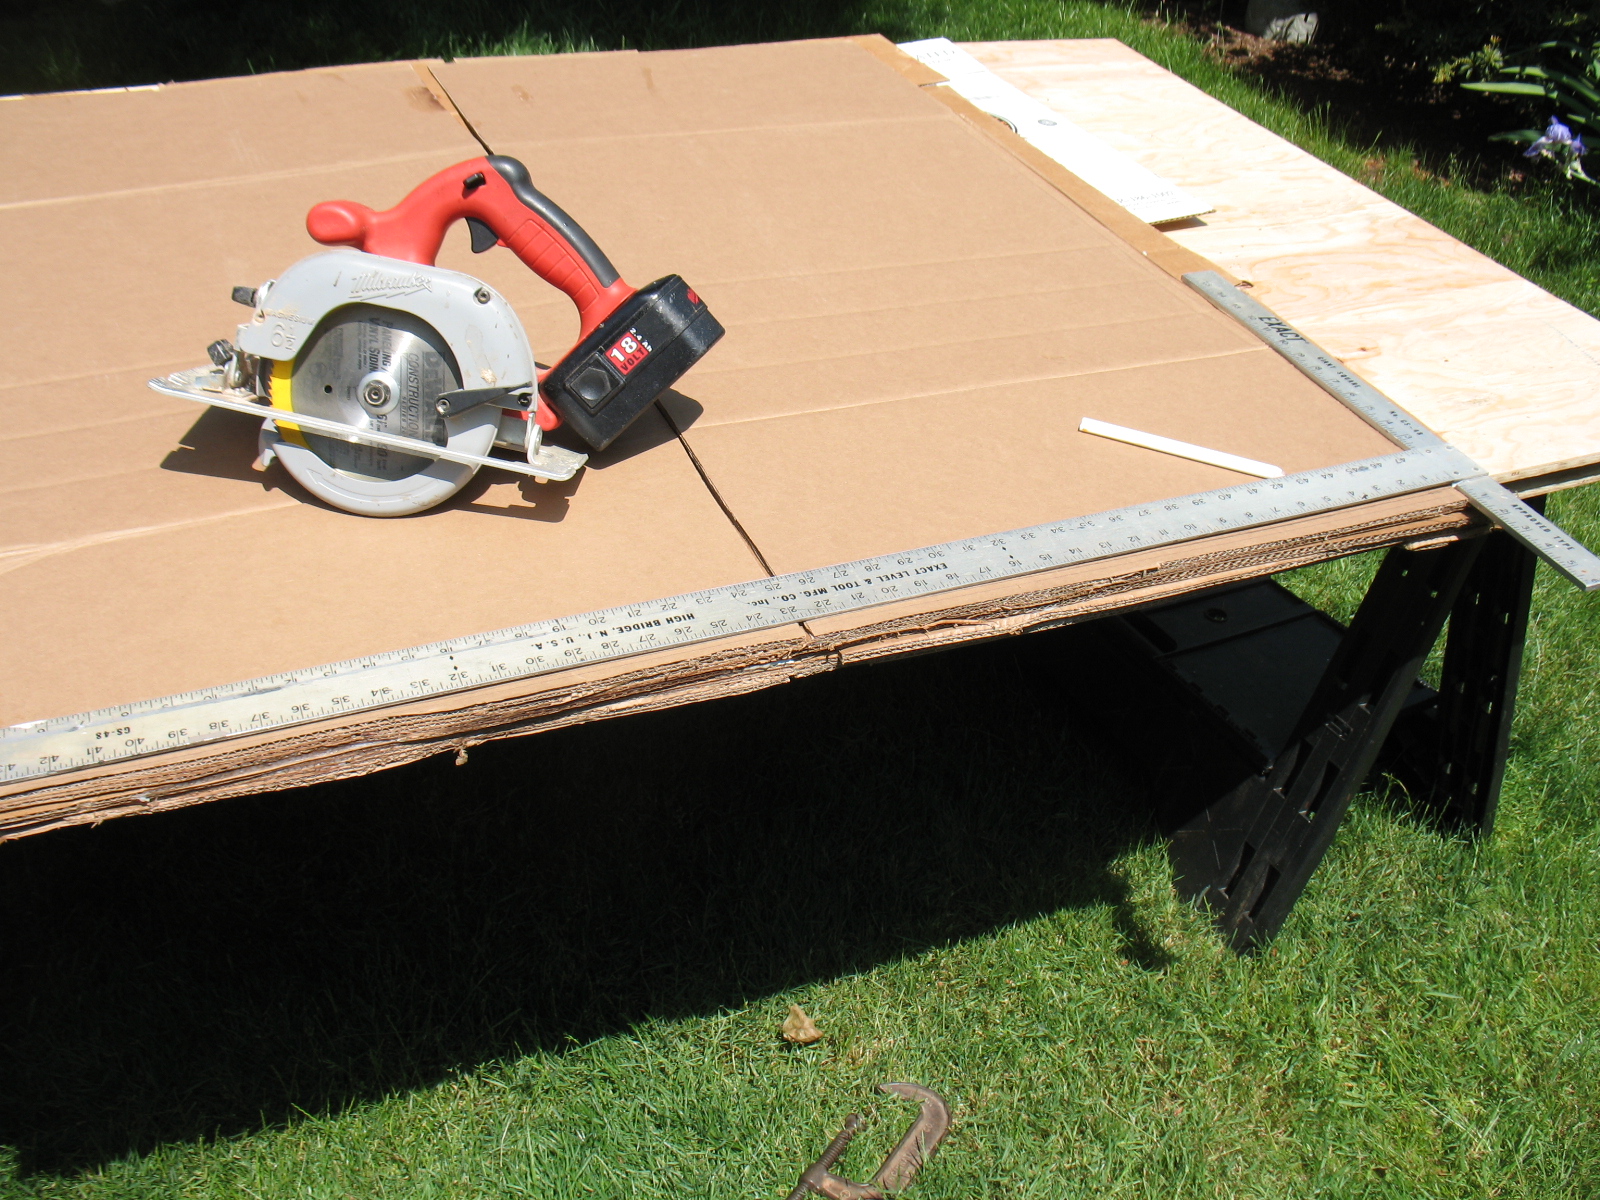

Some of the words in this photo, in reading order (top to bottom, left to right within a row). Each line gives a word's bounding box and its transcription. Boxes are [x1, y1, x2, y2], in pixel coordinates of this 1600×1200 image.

[629, 327, 643, 341] 2.4
[1258, 316, 1307, 342] EXACT
[610, 336, 638, 362] 18
[369, 347, 380, 372] SIDIN
[620, 347, 645, 371] VOLT
[407, 352, 420, 439] CONSTRUCTION
[1511, 504, 1551, 532] APPROVED
[1553, 535, 1575, 550] TYPE
[914, 562, 949, 575] EXACT
[864, 577, 873, 585] &
[876, 570, 911, 582] LEVEL
[946, 572, 960, 580] 18
[830, 580, 862, 592] TOOL
[914, 579, 928, 587] 19
[799, 587, 829, 598] MFG.
[881, 585, 898, 594] 20
[851, 592, 865, 601] 21
[747, 598, 771, 607] Inc.
[814, 599, 832, 608] 22
[780, 606, 797, 615] 23
[665, 613, 696, 625] HIGH
[745, 612, 763, 621] 24
[612, 619, 661, 634] BRIDGE,
[710, 620, 727, 629] 25
[674, 626, 693, 635] 26
[639, 633, 656, 643] 27
[601, 640, 620, 650] 28
[564, 647, 583, 657] 29
[526, 655, 545, 665] 30
[449, 671, 468, 681] 32
[410, 679, 430, 689] 33
[331, 695, 350, 705] 35
[292, 703, 310, 713] 36
[251, 711, 270, 722] 37
[209, 720, 229, 730] 38
[168, 728, 187, 738] 39
[125, 738, 145, 747] 40
[40, 755, 59, 765] 42
